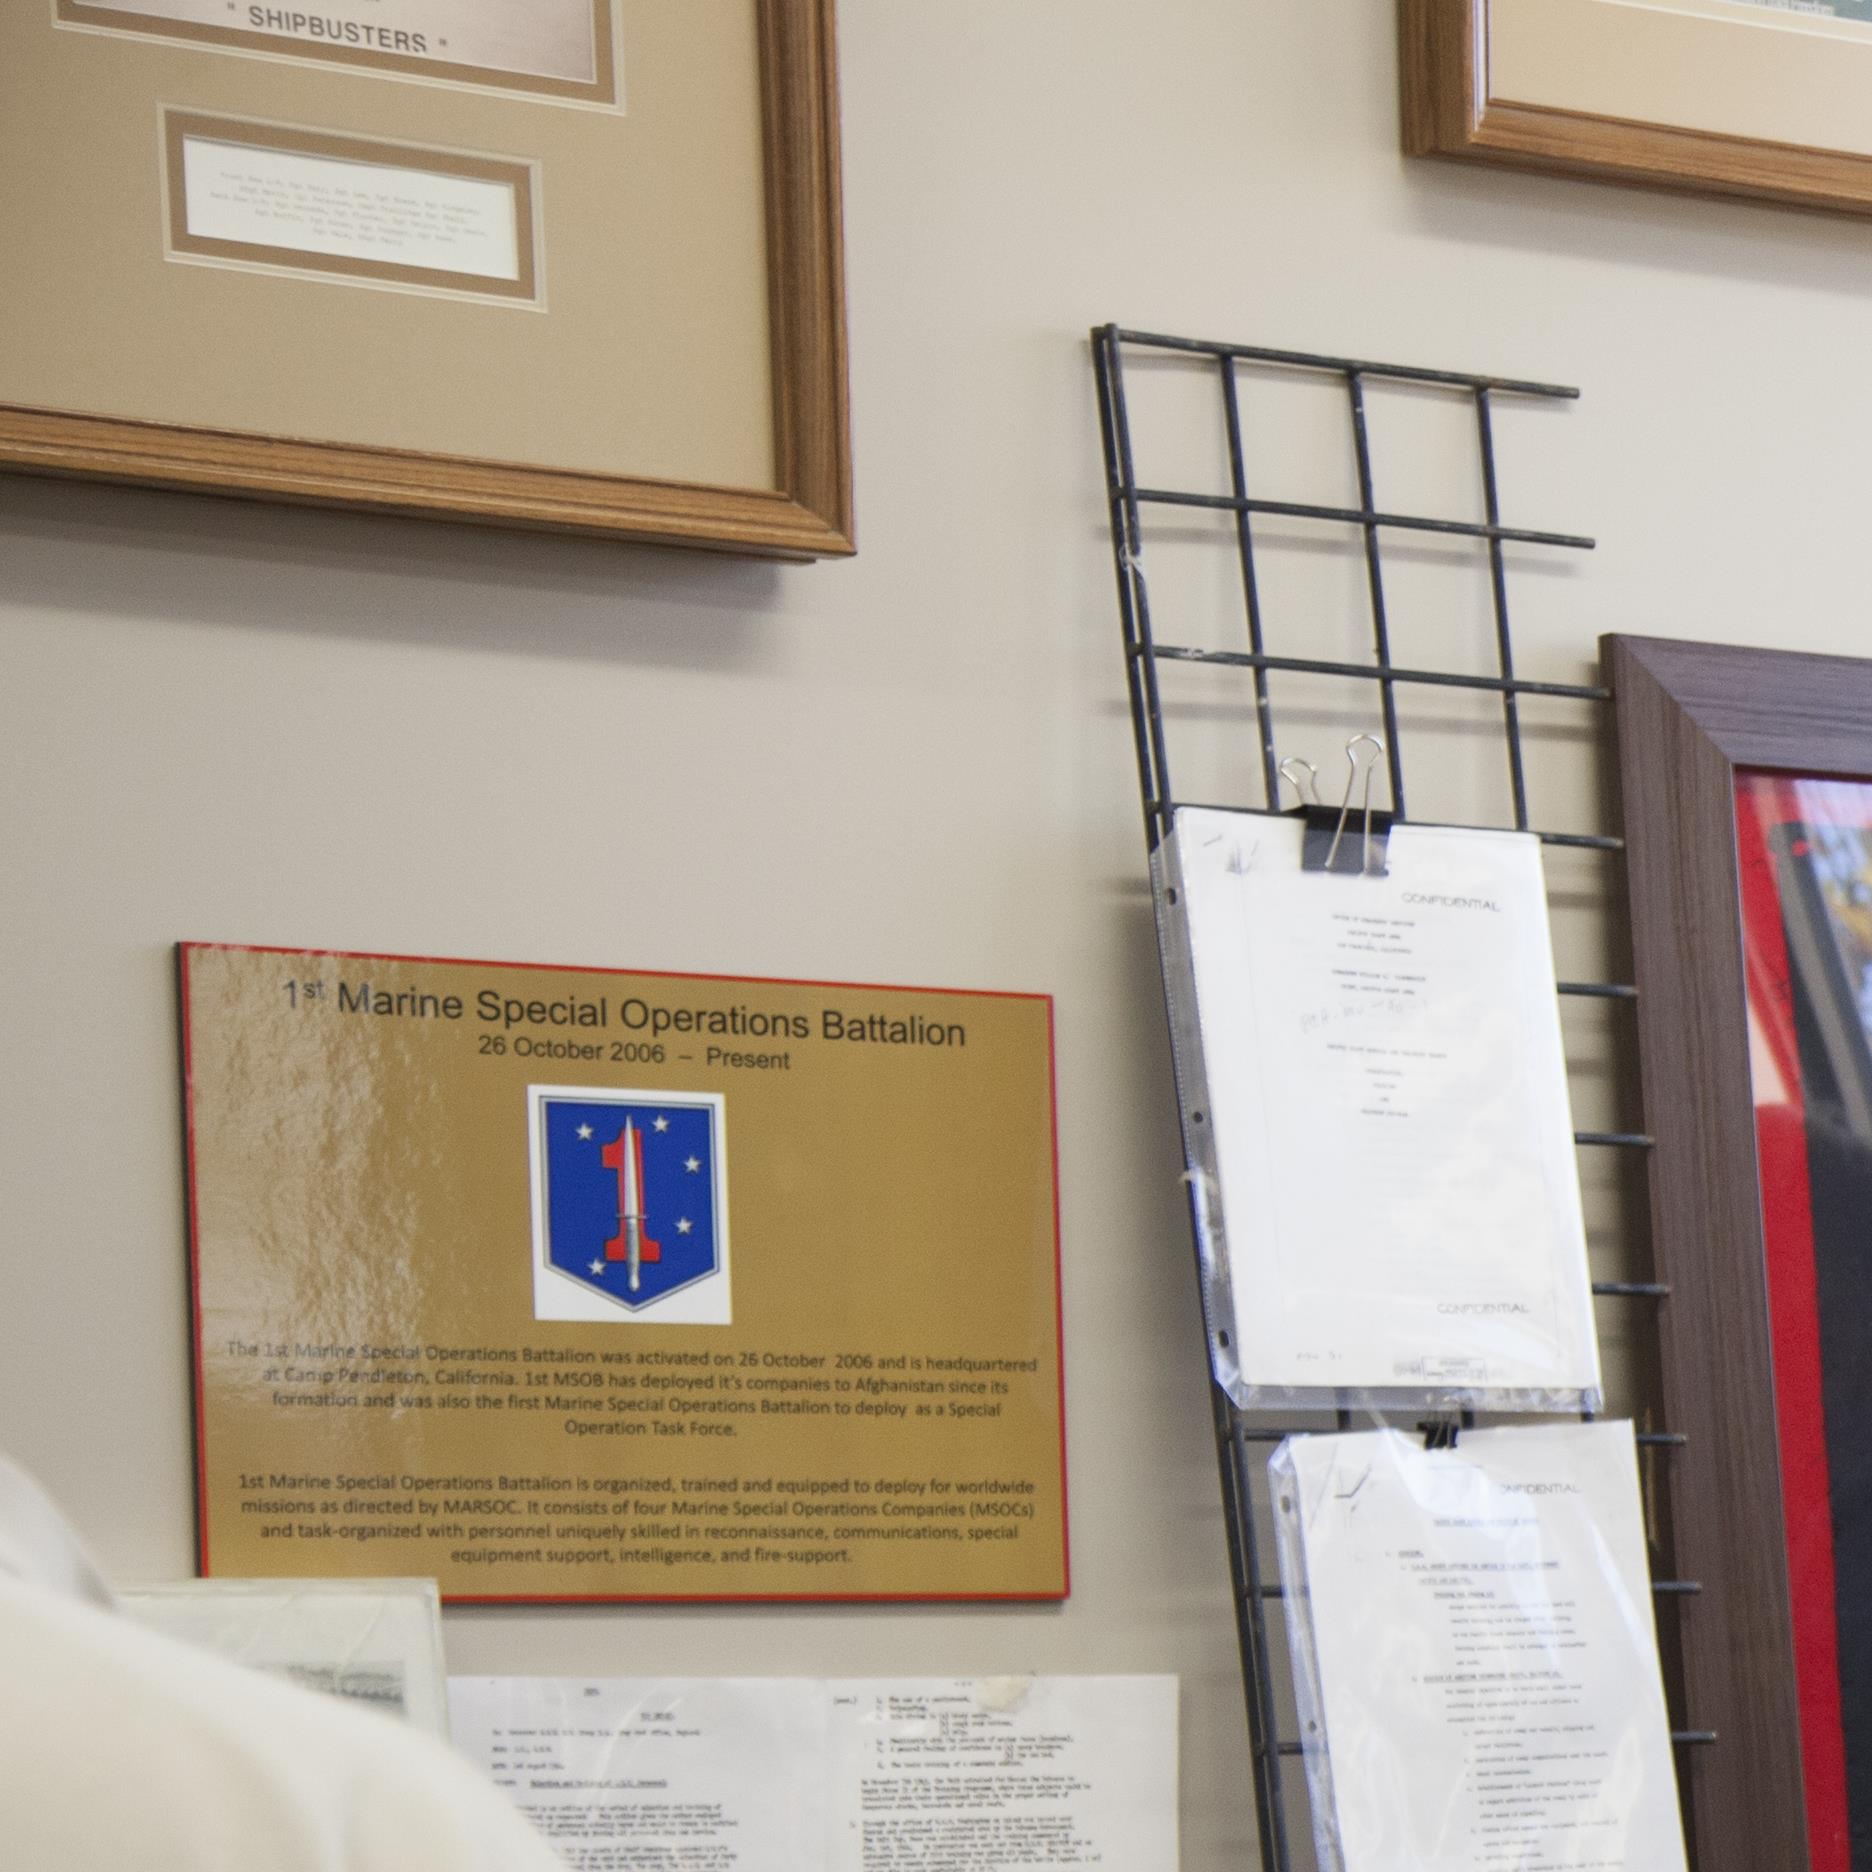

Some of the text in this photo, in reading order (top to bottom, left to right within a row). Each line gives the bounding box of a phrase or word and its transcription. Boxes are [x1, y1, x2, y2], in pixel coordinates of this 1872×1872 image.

[249, 5, 427, 52] SHIPBUSTERS
[284, 979, 966, 1047] 1st Marine Special Operations Battalion
[478, 1034, 790, 1071] 26 October 2006 Present
[362, 1344, 420, 1362] Special
[426, 1344, 518, 1363] Operations
[522, 1347, 596, 1363] Battalion
[600, 1352, 632, 1364] was
[636, 1349, 711, 1365] activated
[714, 1352, 734, 1366] on
[739, 1351, 759, 1367] 26
[762, 1352, 826, 1368] October
[835, 1354, 873, 1369] 2006
[878, 1355, 907, 1370] and
[910, 1359, 922, 1370] is
[926, 1356, 1038, 1374] headquartered
[526, 1372, 548, 1386] 1st
[553, 1372, 604, 1387] MSOB
[608, 1373, 636, 1387] has
[640, 1374, 714, 1390] deployed
[746, 1379, 830, 1393] companies
[834, 1379, 851, 1392] to
[855, 1377, 944, 1396] Afghanistan
[948, 1382, 987, 1394] since
[990, 1381, 1008, 1394] its
[363, 1392, 396, 1408] and
[403, 1396, 433, 1409] was
[438, 1395, 471, 1409] also
[476, 1395, 504, 1409] the
[508, 1394, 540, 1410] first
[545, 1396, 603, 1411] Marine
[608, 1397, 664, 1413] Special
[669, 1398, 757, 1415] Operations
[761, 1399, 831, 1415] Battalion
[834, 1402, 852, 1415] to
[855, 1401, 907, 1418] deploy
[915, 1405, 932, 1416] as
[936, 1405, 945, 1416] a
[949, 1402, 1001, 1419] Special
[564, 1419, 647, 1437] Operation
[652, 1421, 685, 1436] Task
[239, 1474, 264, 1489] 1st
[269, 1474, 331, 1489] Marine
[336, 1474, 396, 1492] Special
[400, 1476, 493, 1492] Operations
[498, 1475, 572, 1491] Battalion
[577, 1479, 589, 1491] is
[681, 1478, 738, 1492] trained
[742, 1478, 772, 1492] and
[776, 1478, 850, 1495] equipped
[853, 1480, 870, 1493] to
[874, 1479, 926, 1495] deploy
[929, 1478, 951, 1493] for
[955, 1480, 1034, 1494] worldwide
[241, 1499, 316, 1514] missions
[320, 1502, 339, 1513] as
[343, 1499, 414, 1514] directed
[418, 1500, 439, 1516] by
[528, 1501, 539, 1514] It
[543, 1502, 608, 1515] consists
[612, 1500, 630, 1515] of
[633, 1500, 666, 1515] four
[672, 1501, 729, 1515] Marine
[733, 1501, 787, 1517] Special
[792, 1502, 878, 1517] Operations
[881, 1502, 965, 1518] Companies
[969, 1502, 1034, 1519] (MSOCs)
[260, 1523, 294, 1538] and
[297, 1523, 422, 1542] task-organized
[427, 1525, 464, 1538] with
[469, 1525, 551, 1540] personnel
[556, 1525, 626, 1541] uniquely
[631, 1525, 681, 1539] skilled
[686, 1528, 700, 1537] in
[968, 1526, 1018, 1541] special
[450, 1549, 542, 1564] equipment
[721, 1548, 751, 1562] and
